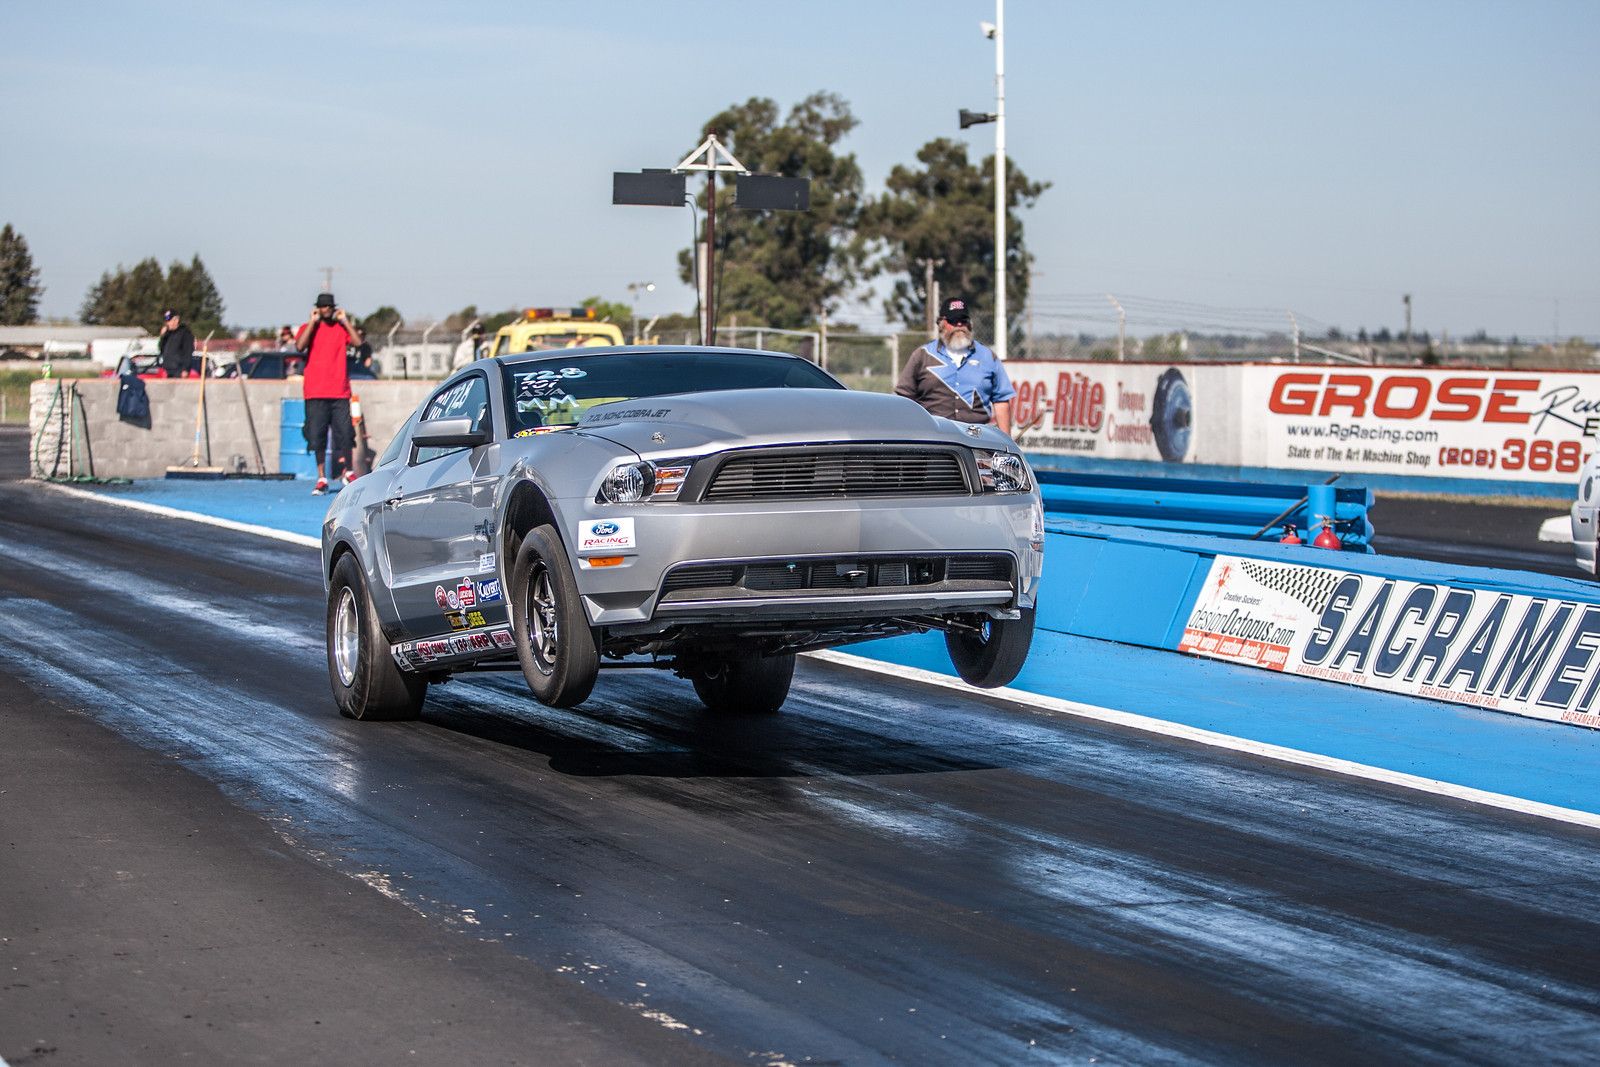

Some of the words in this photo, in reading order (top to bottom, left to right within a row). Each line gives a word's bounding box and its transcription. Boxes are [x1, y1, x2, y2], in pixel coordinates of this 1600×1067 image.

[1269, 373, 1541, 424] GROSE
[623, 409, 652, 418] COBRA
[651, 409, 671, 418] JET
[1287, 423, 1439, 444] www.RgRacing.com
[1288, 445, 1311, 459] State
[1315, 447, 1324, 459] of
[1327, 447, 1343, 461] The
[1346, 448, 1360, 462] Art
[1362, 450, 1403, 464] Machine
[1406, 451, 1431, 468] Shop
[595, 522, 615, 534] Ford
[584, 537, 629, 546] RACING
[1189, 603, 1295, 646] designOctopus.com
[1418, 686, 1456, 700] SACRAMENTO
[1455, 692, 1483, 704] RACEWAY
[1483, 697, 1499, 707] PARK
